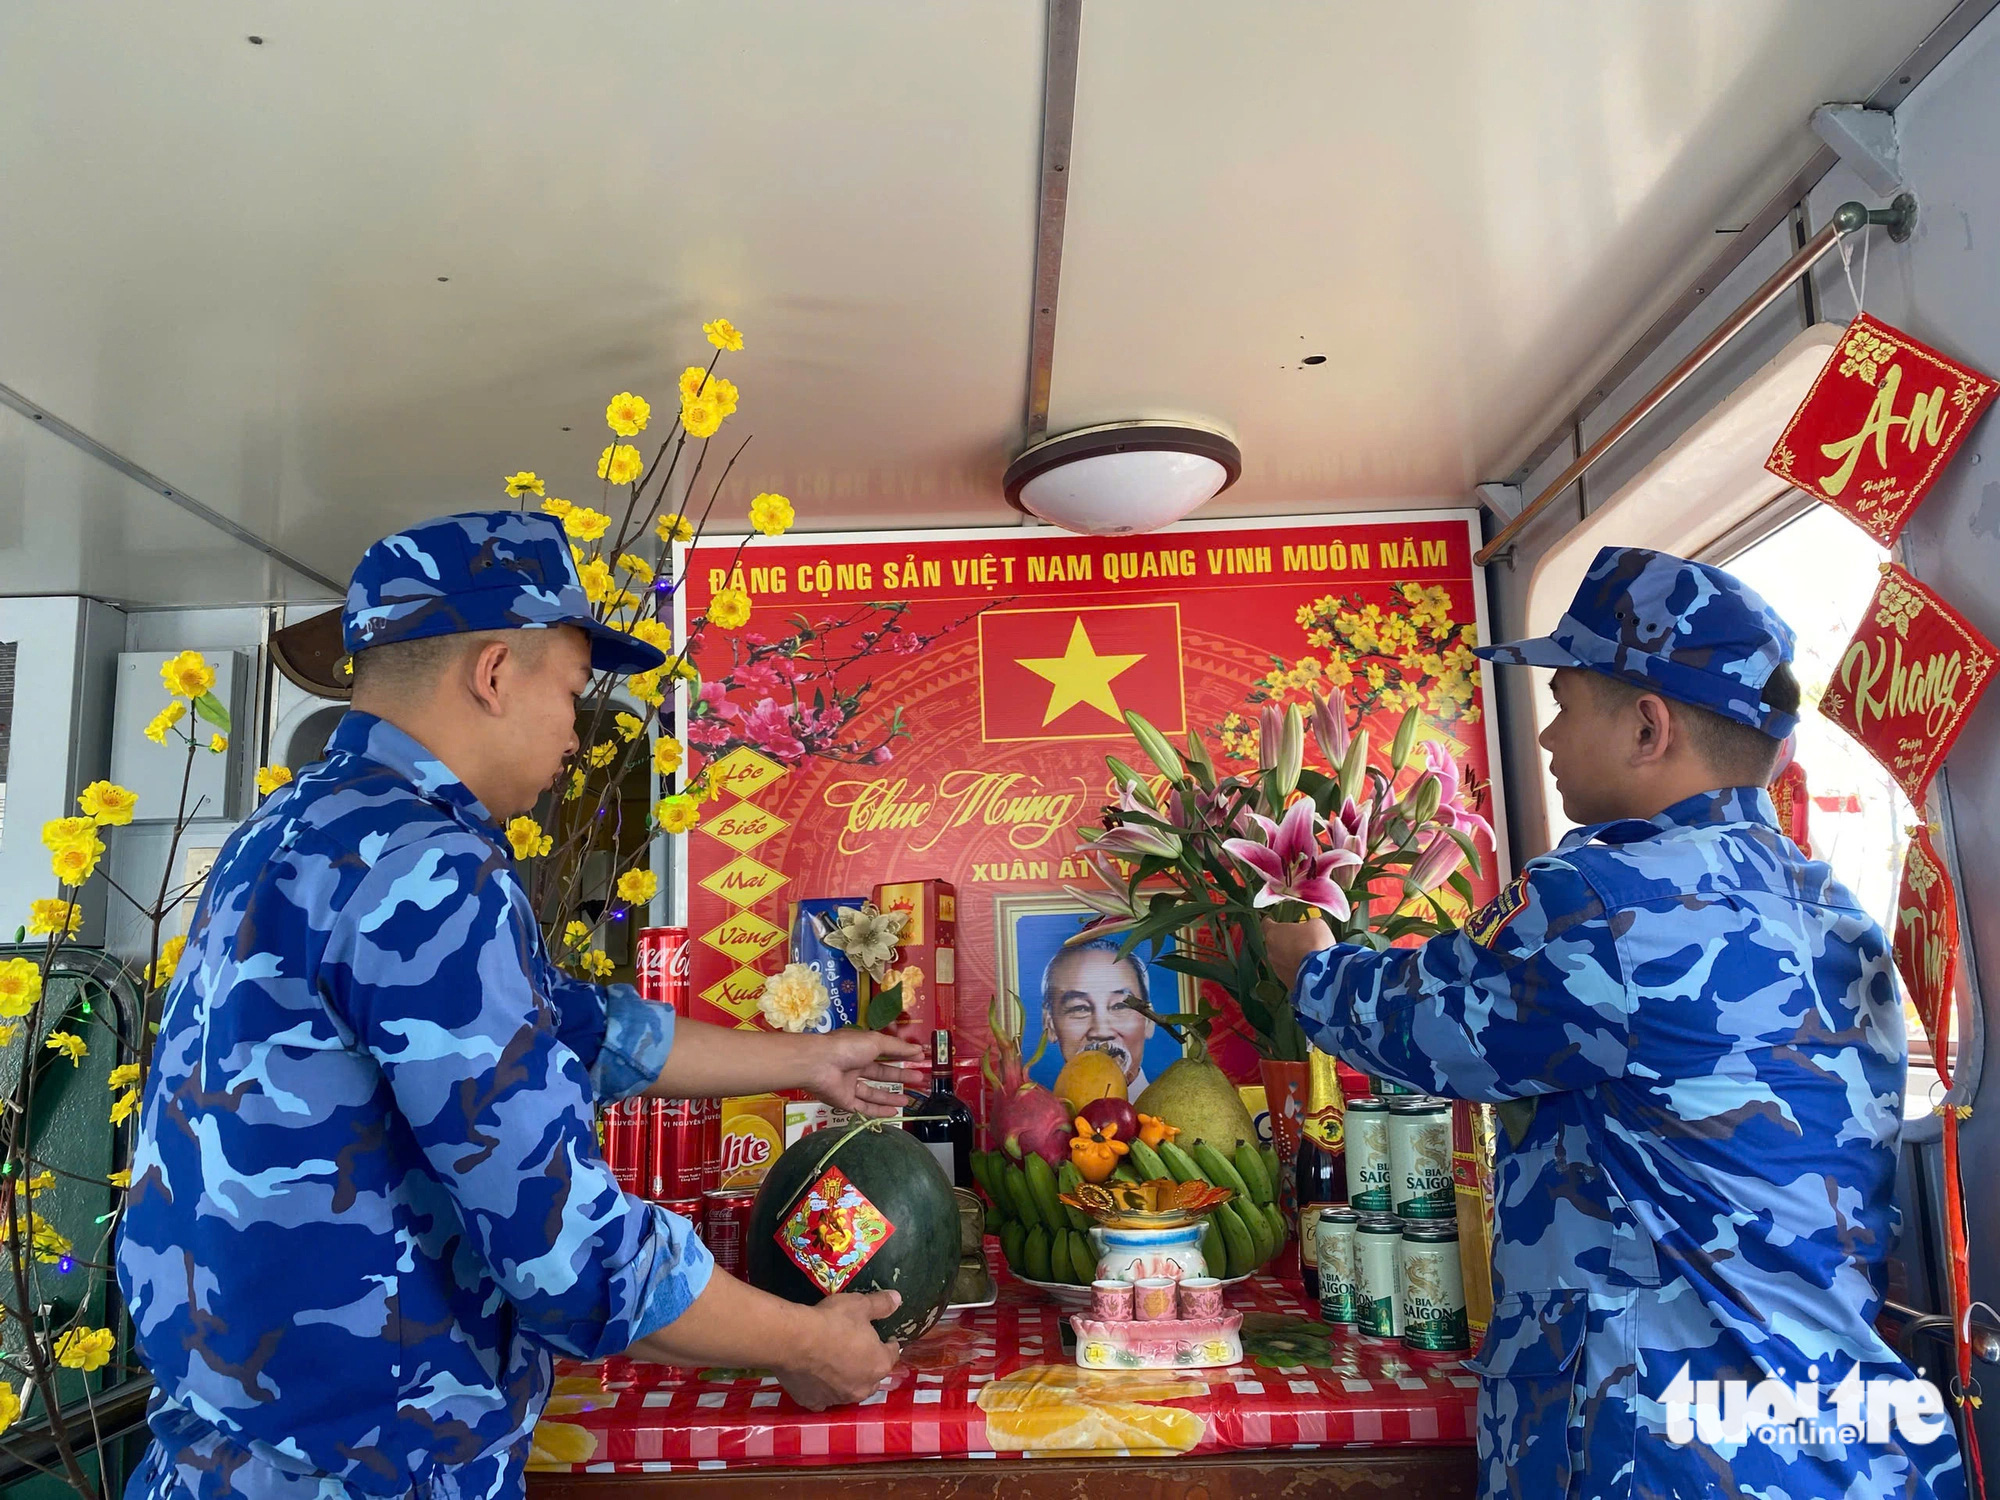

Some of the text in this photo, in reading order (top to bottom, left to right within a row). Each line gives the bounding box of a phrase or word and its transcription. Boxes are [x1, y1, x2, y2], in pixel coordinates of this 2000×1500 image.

[1861, 475, 1897, 494] Happy
[1856, 489, 1905, 513] New Year
[708, 537, 1449, 598] ĐẢNG CỘNG SẢN VIỆT NAM QUANG VINH MUÔN NĂM
[1841, 635, 1962, 738] Khang
[1898, 737, 1923, 751] Happy
[726, 763, 764, 783] Lộc
[824, 776, 938, 855] Chúc
[907, 770, 1087, 852] Mừng
[716, 814, 768, 837] Biếc
[720, 871, 768, 890] Mai
[971, 859, 1049, 883] XUÂN
[718, 926, 779, 948] Vàng
[716, 982, 767, 1006] Xuâ
[1360, 1170, 1390, 1184] SAIG
[1425, 1168, 1442, 1177] BIA
[1326, 1273, 1341, 1283] BIA
[1320, 1282, 1355, 1295] AIGON
[1403, 1303, 1453, 1320] SAIGON
[1415, 1297, 1432, 1307] BIA
[1407, 1319, 1449, 1331] LAGER
